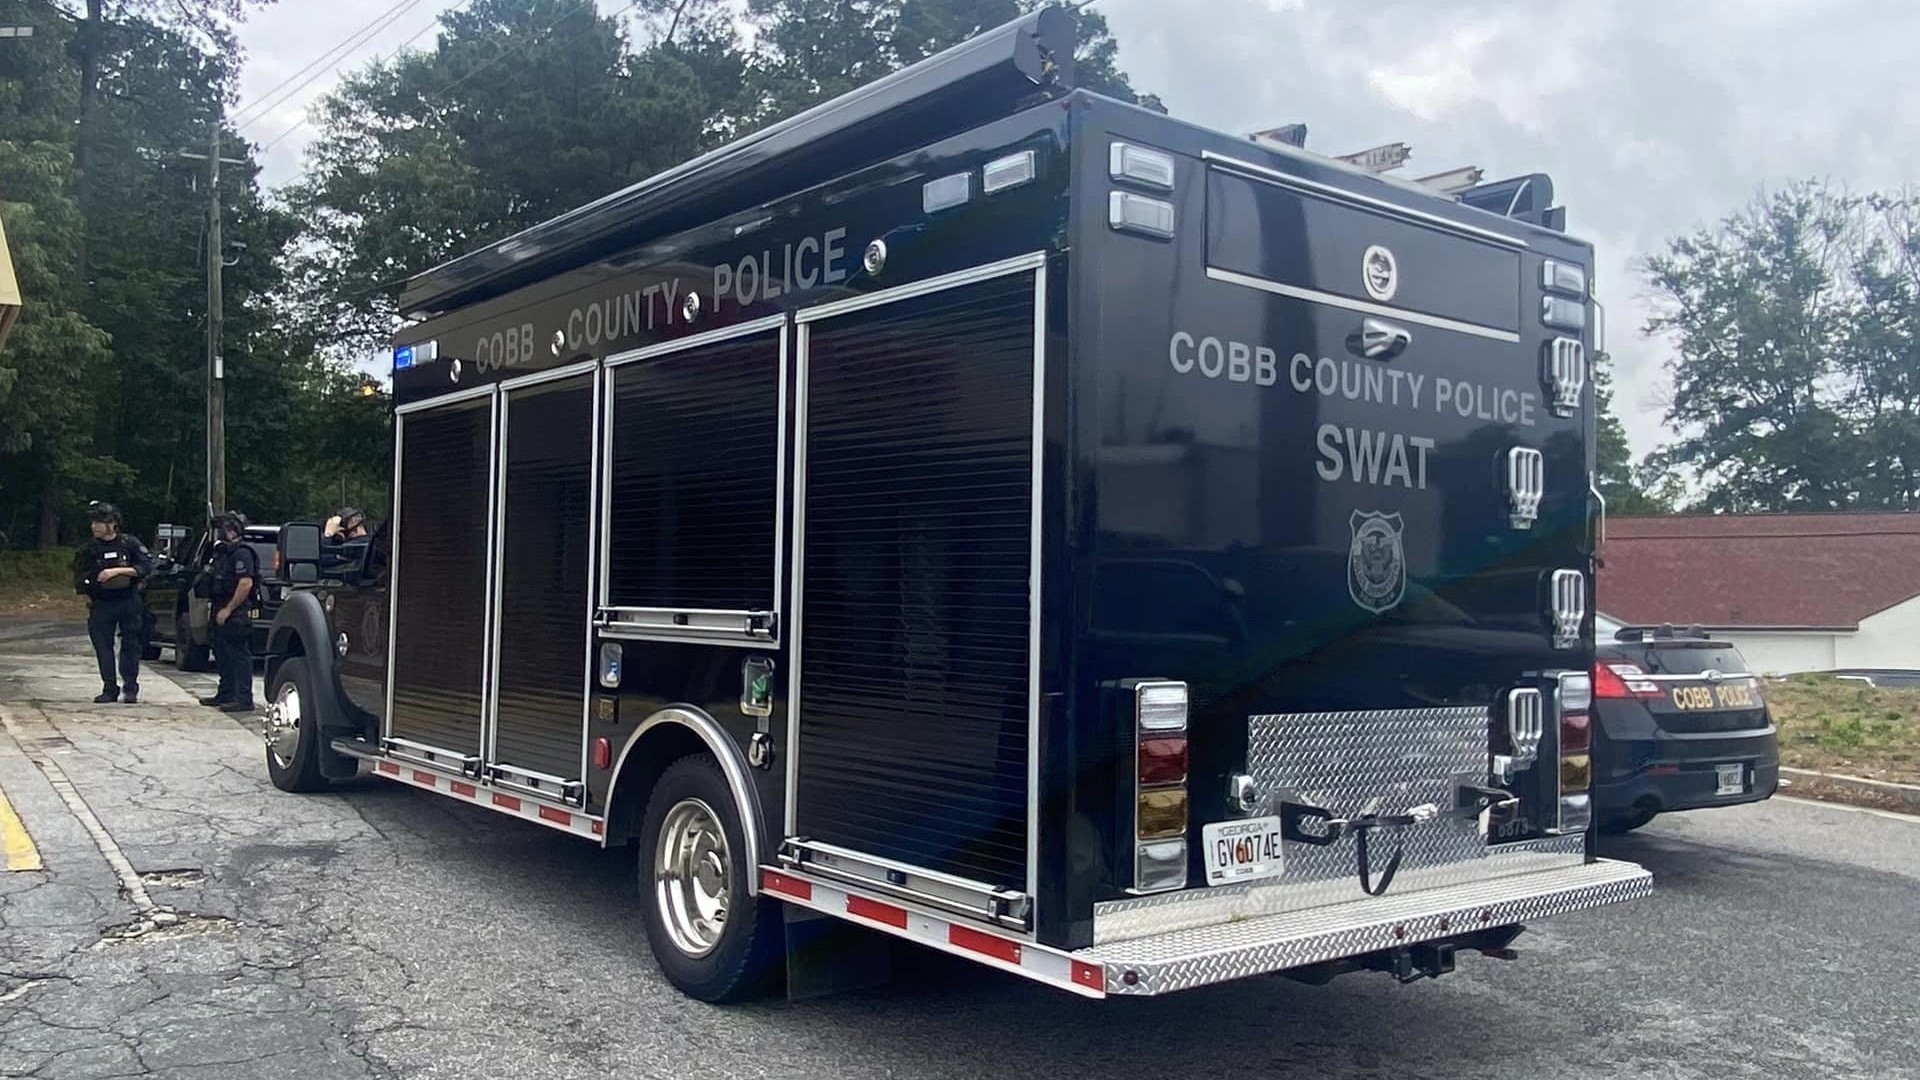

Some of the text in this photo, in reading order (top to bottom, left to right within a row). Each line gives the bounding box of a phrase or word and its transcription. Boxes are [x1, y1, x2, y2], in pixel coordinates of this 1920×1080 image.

[476, 227, 847, 374] COBB COUNTY POLICE
[1169, 331, 1535, 426] COBB COUNTY POLICE
[1316, 424, 1435, 490] SWAT
[1672, 685, 1753, 710] COBB POLICE
[1217, 832, 1280, 867] GV6074E
